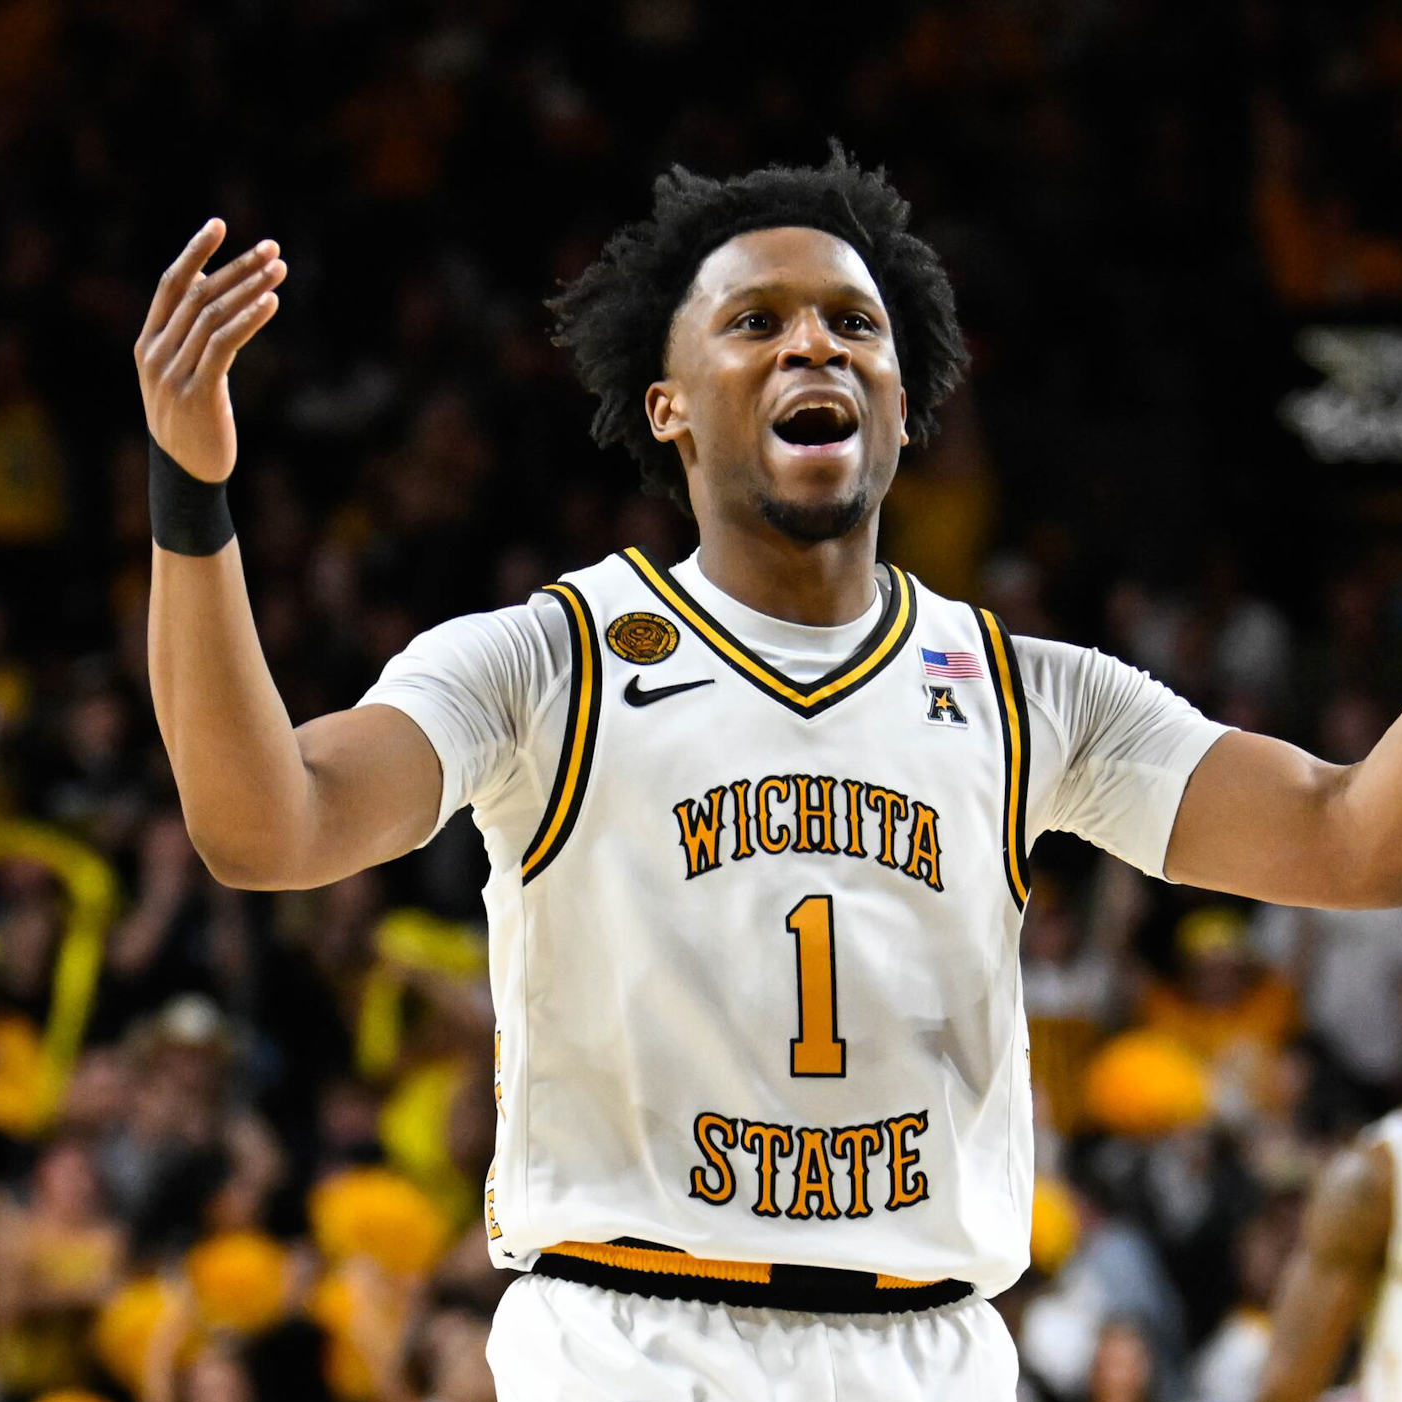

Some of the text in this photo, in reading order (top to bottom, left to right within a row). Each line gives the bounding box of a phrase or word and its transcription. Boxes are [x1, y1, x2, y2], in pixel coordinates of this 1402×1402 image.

[672, 773, 945, 893] WICHITA
[785, 894, 846, 1079] 1
[689, 1110, 931, 1220] STATE
